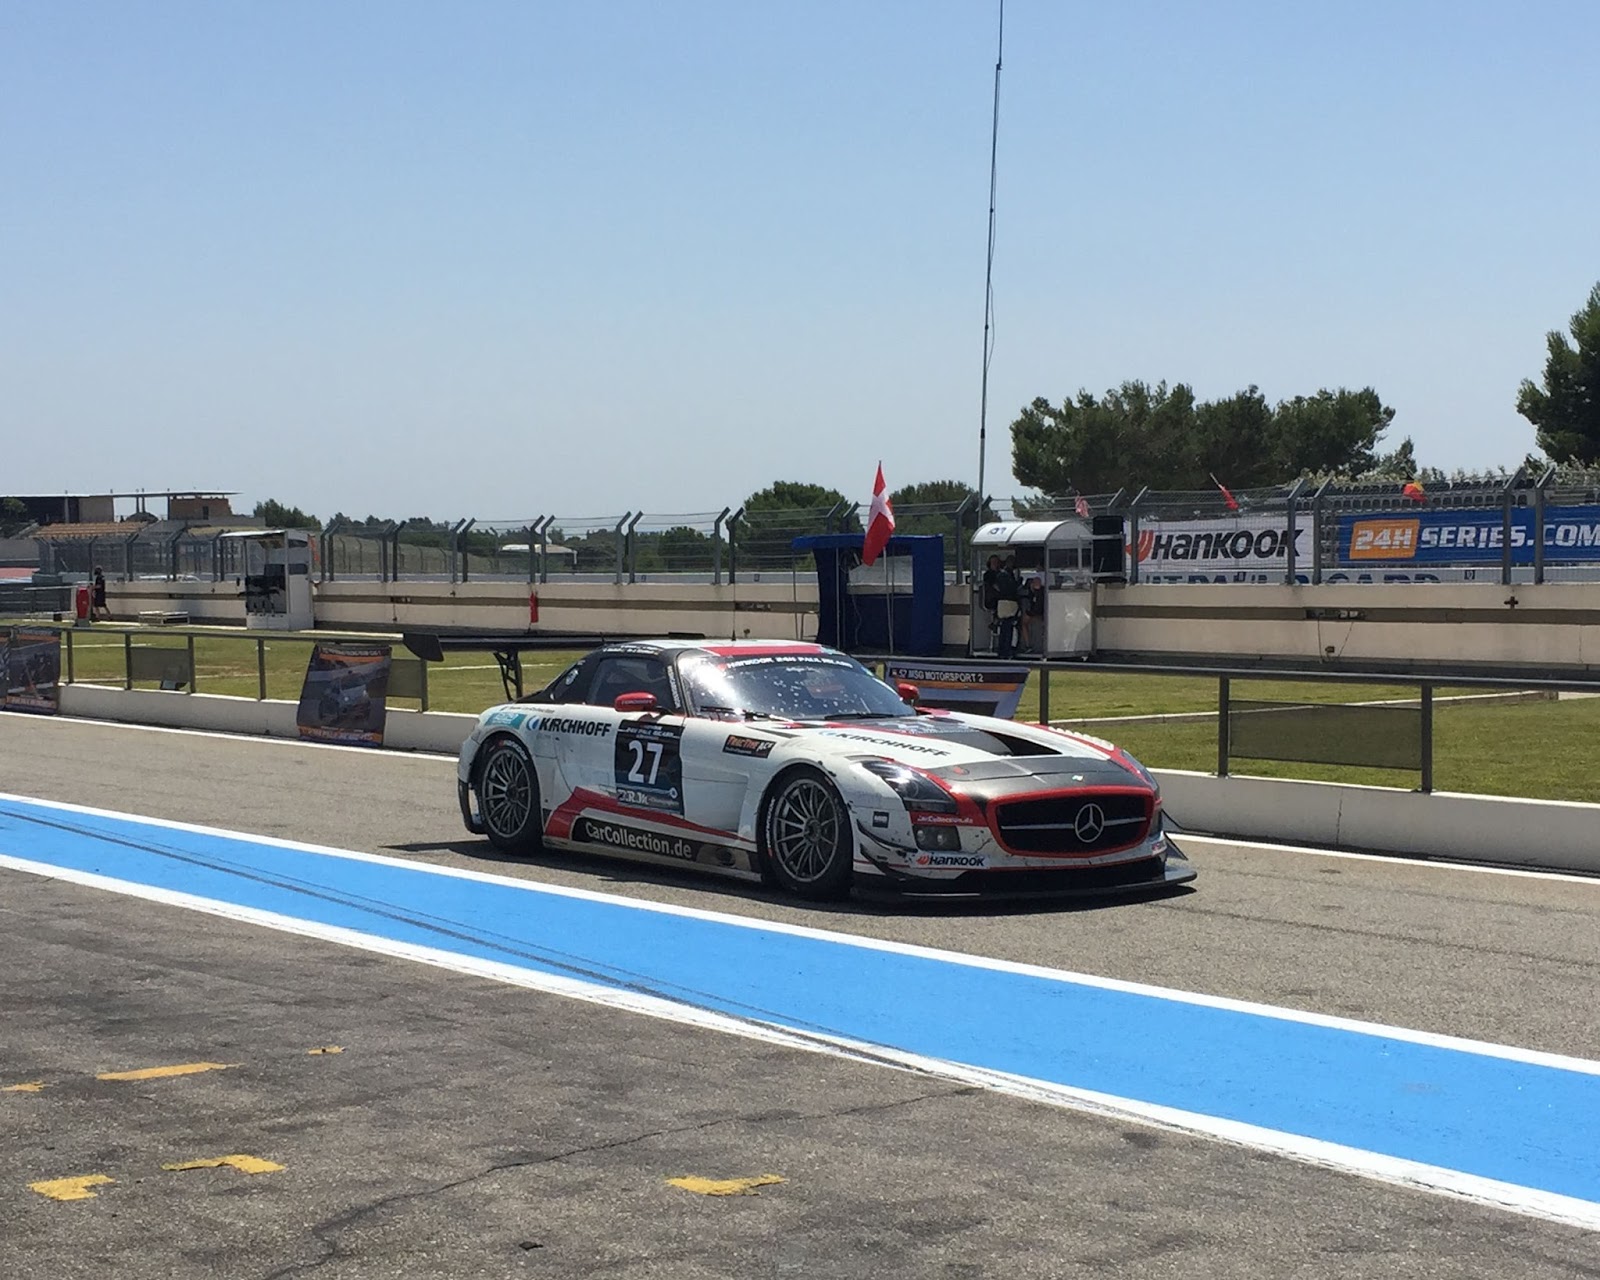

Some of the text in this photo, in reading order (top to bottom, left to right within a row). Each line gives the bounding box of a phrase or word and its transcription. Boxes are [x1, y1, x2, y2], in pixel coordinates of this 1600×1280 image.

[1354, 527, 1412, 551] 24H
[925, 671, 976, 683] MOTORSPORT
[978, 673, 984, 683] 2
[539, 717, 612, 737] KIRCHHOFF
[836, 731, 951, 757] KIRCHHOFF
[628, 740, 664, 785] 27
[585, 821, 692, 858] CarCollection.de
